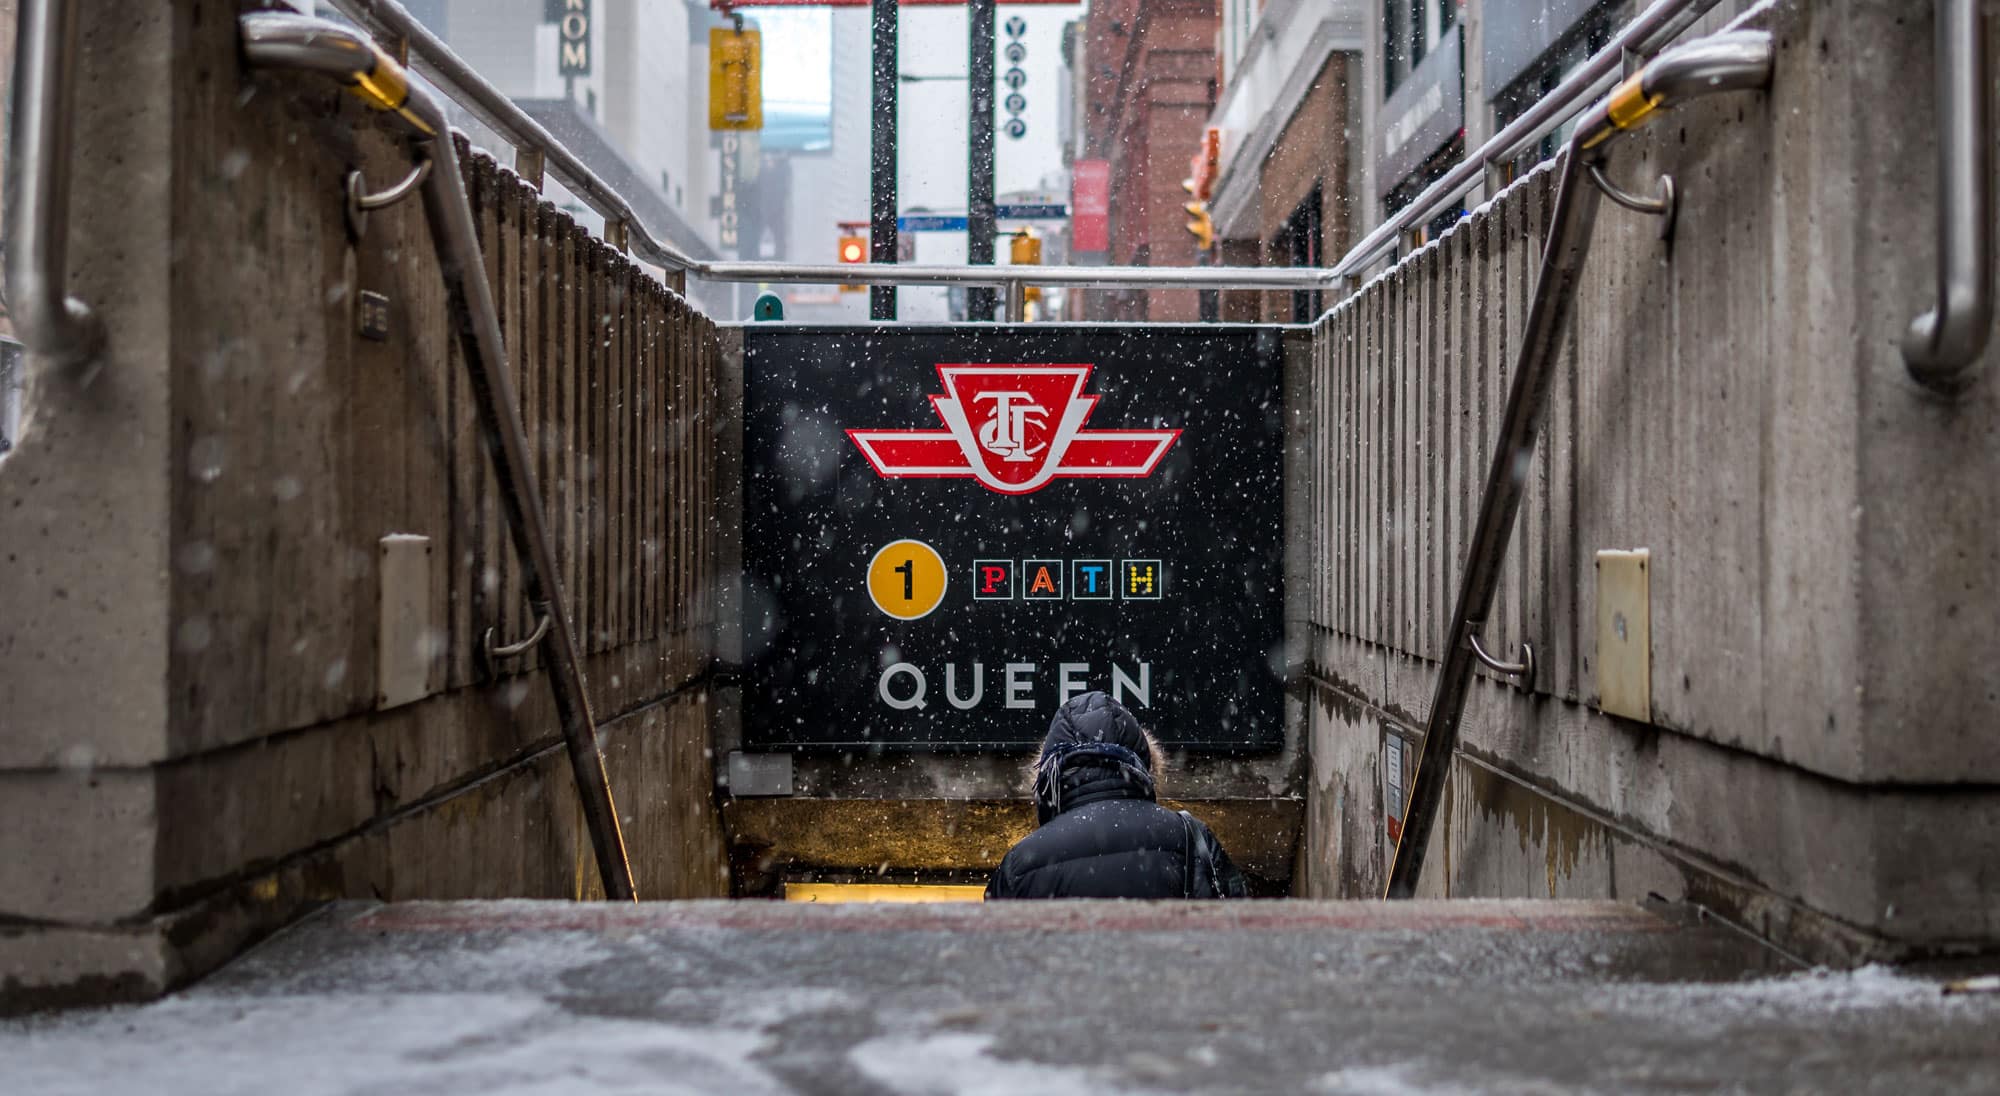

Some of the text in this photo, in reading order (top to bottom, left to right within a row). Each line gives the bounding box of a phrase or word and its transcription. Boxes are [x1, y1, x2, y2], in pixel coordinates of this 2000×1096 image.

[721, 130, 738, 246] DSTROM
[894, 559, 913, 600] 1
[979, 564, 1155, 595] PATH
[879, 662, 1150, 711] QUEEN
